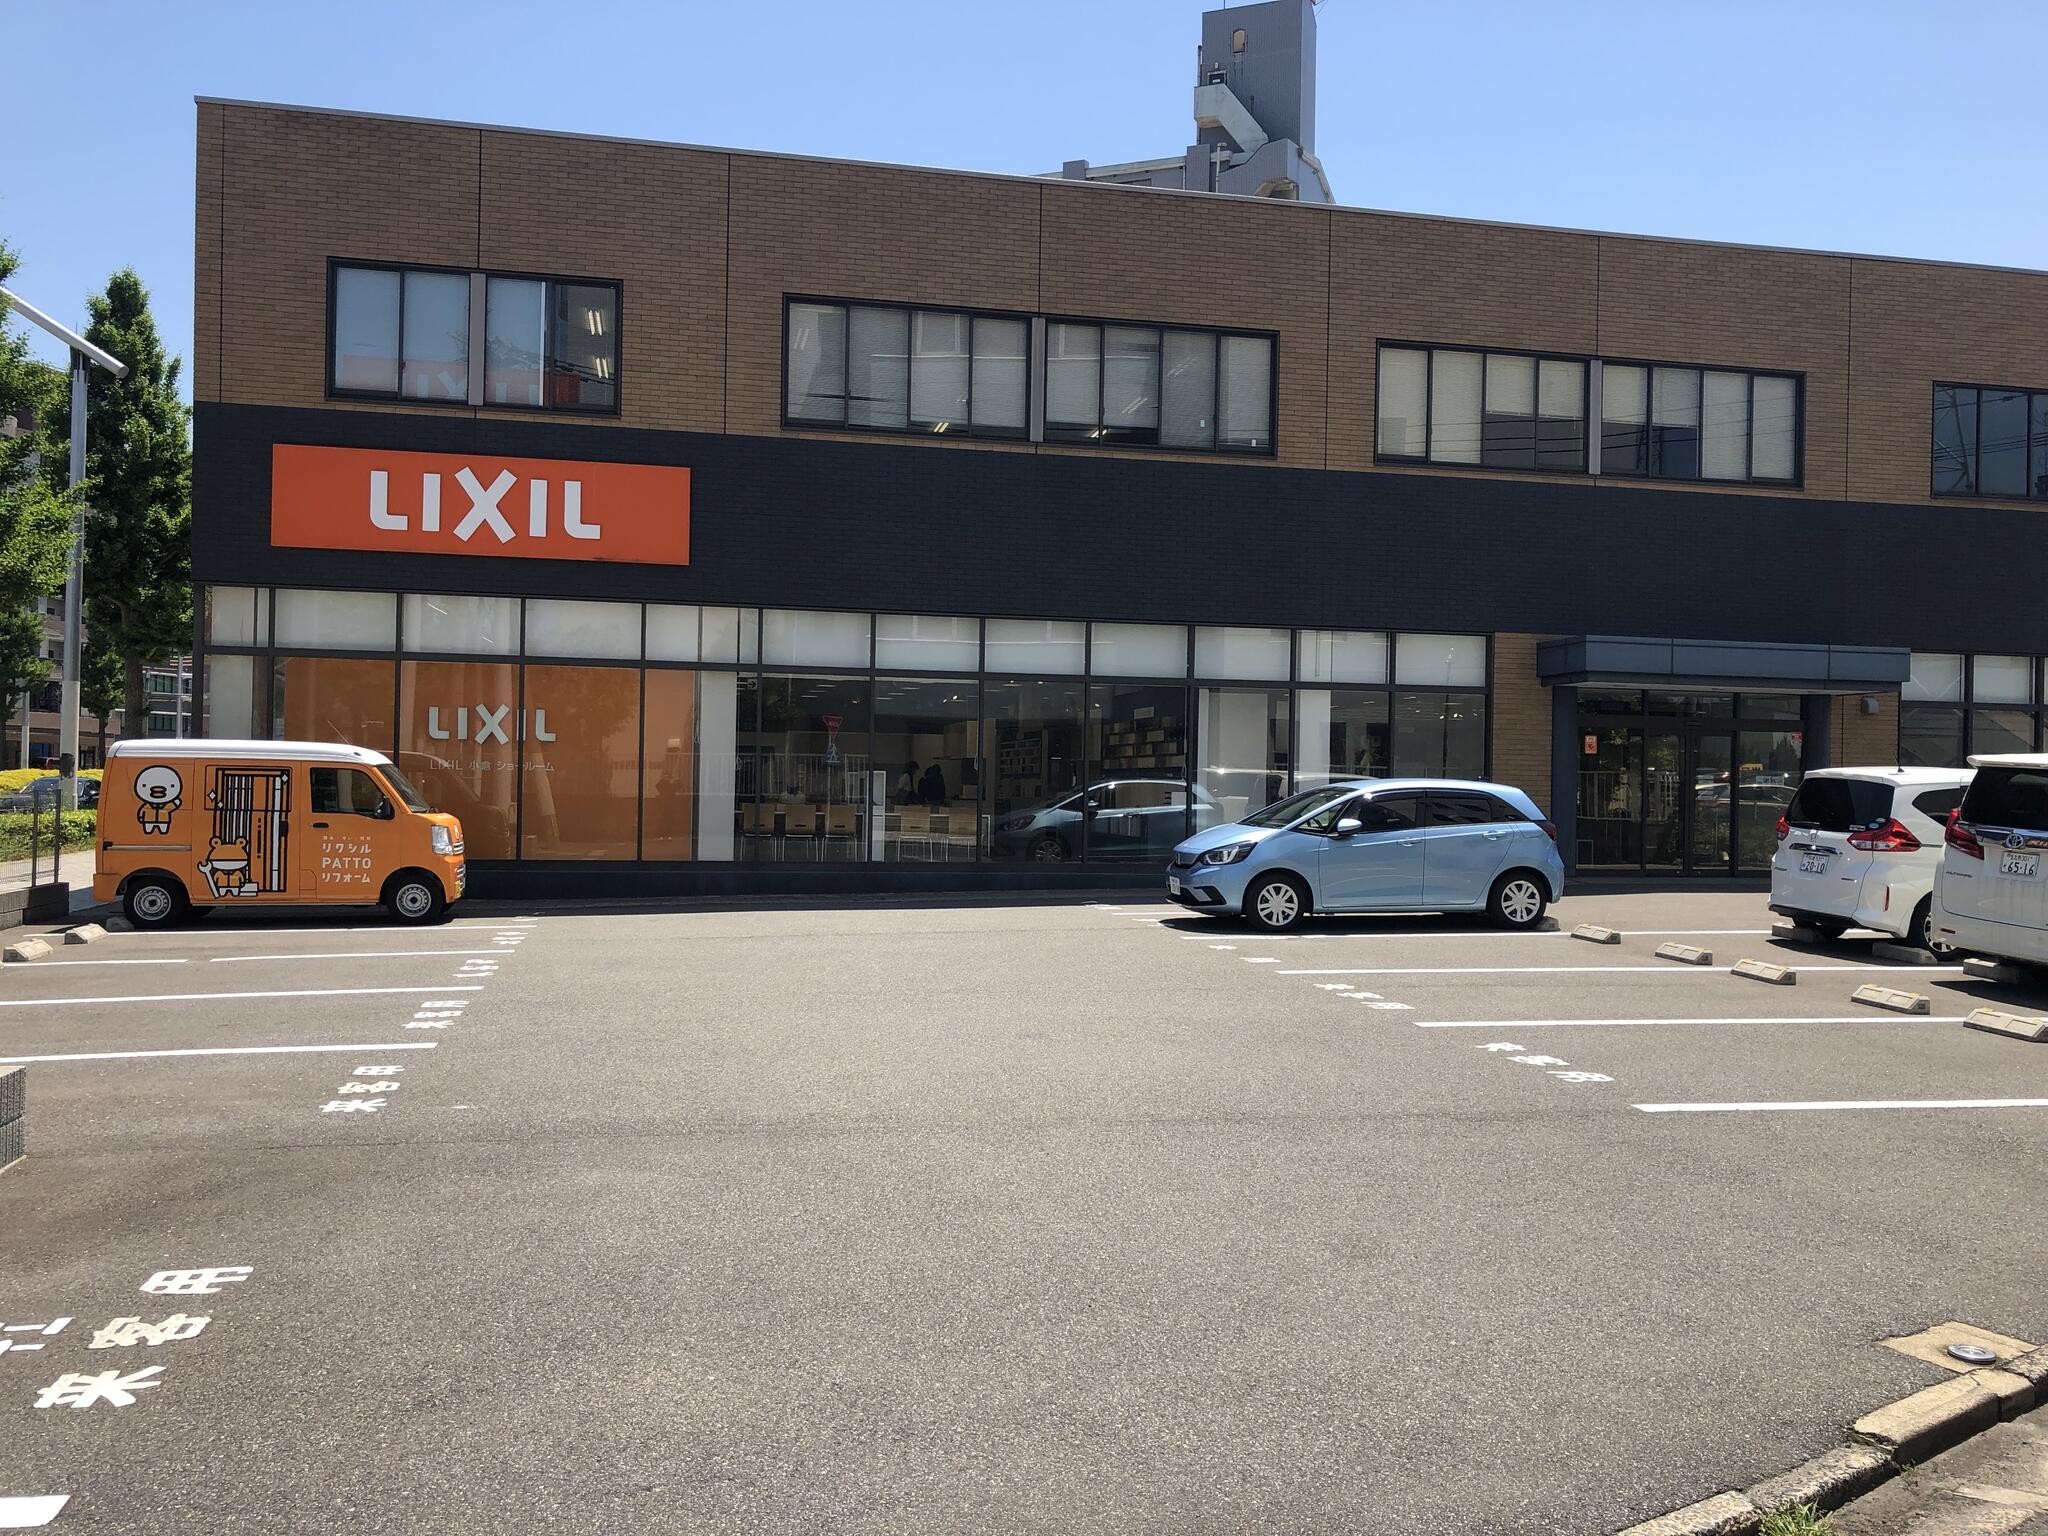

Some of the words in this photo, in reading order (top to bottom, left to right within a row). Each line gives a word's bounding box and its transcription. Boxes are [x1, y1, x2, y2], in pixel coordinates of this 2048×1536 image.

[369, 466, 601, 544] LIXIL
[428, 703, 557, 745] LIXIL
[429, 759, 463, 771] LIXIL
[468, 760, 492, 771] 小倉
[322, 857, 372, 869] PATTO
[2007, 861, 2035, 875] 65-16
[318, 1064, 405, 1113] 来客用
[33, 1266, 254, 1409] 来客用
